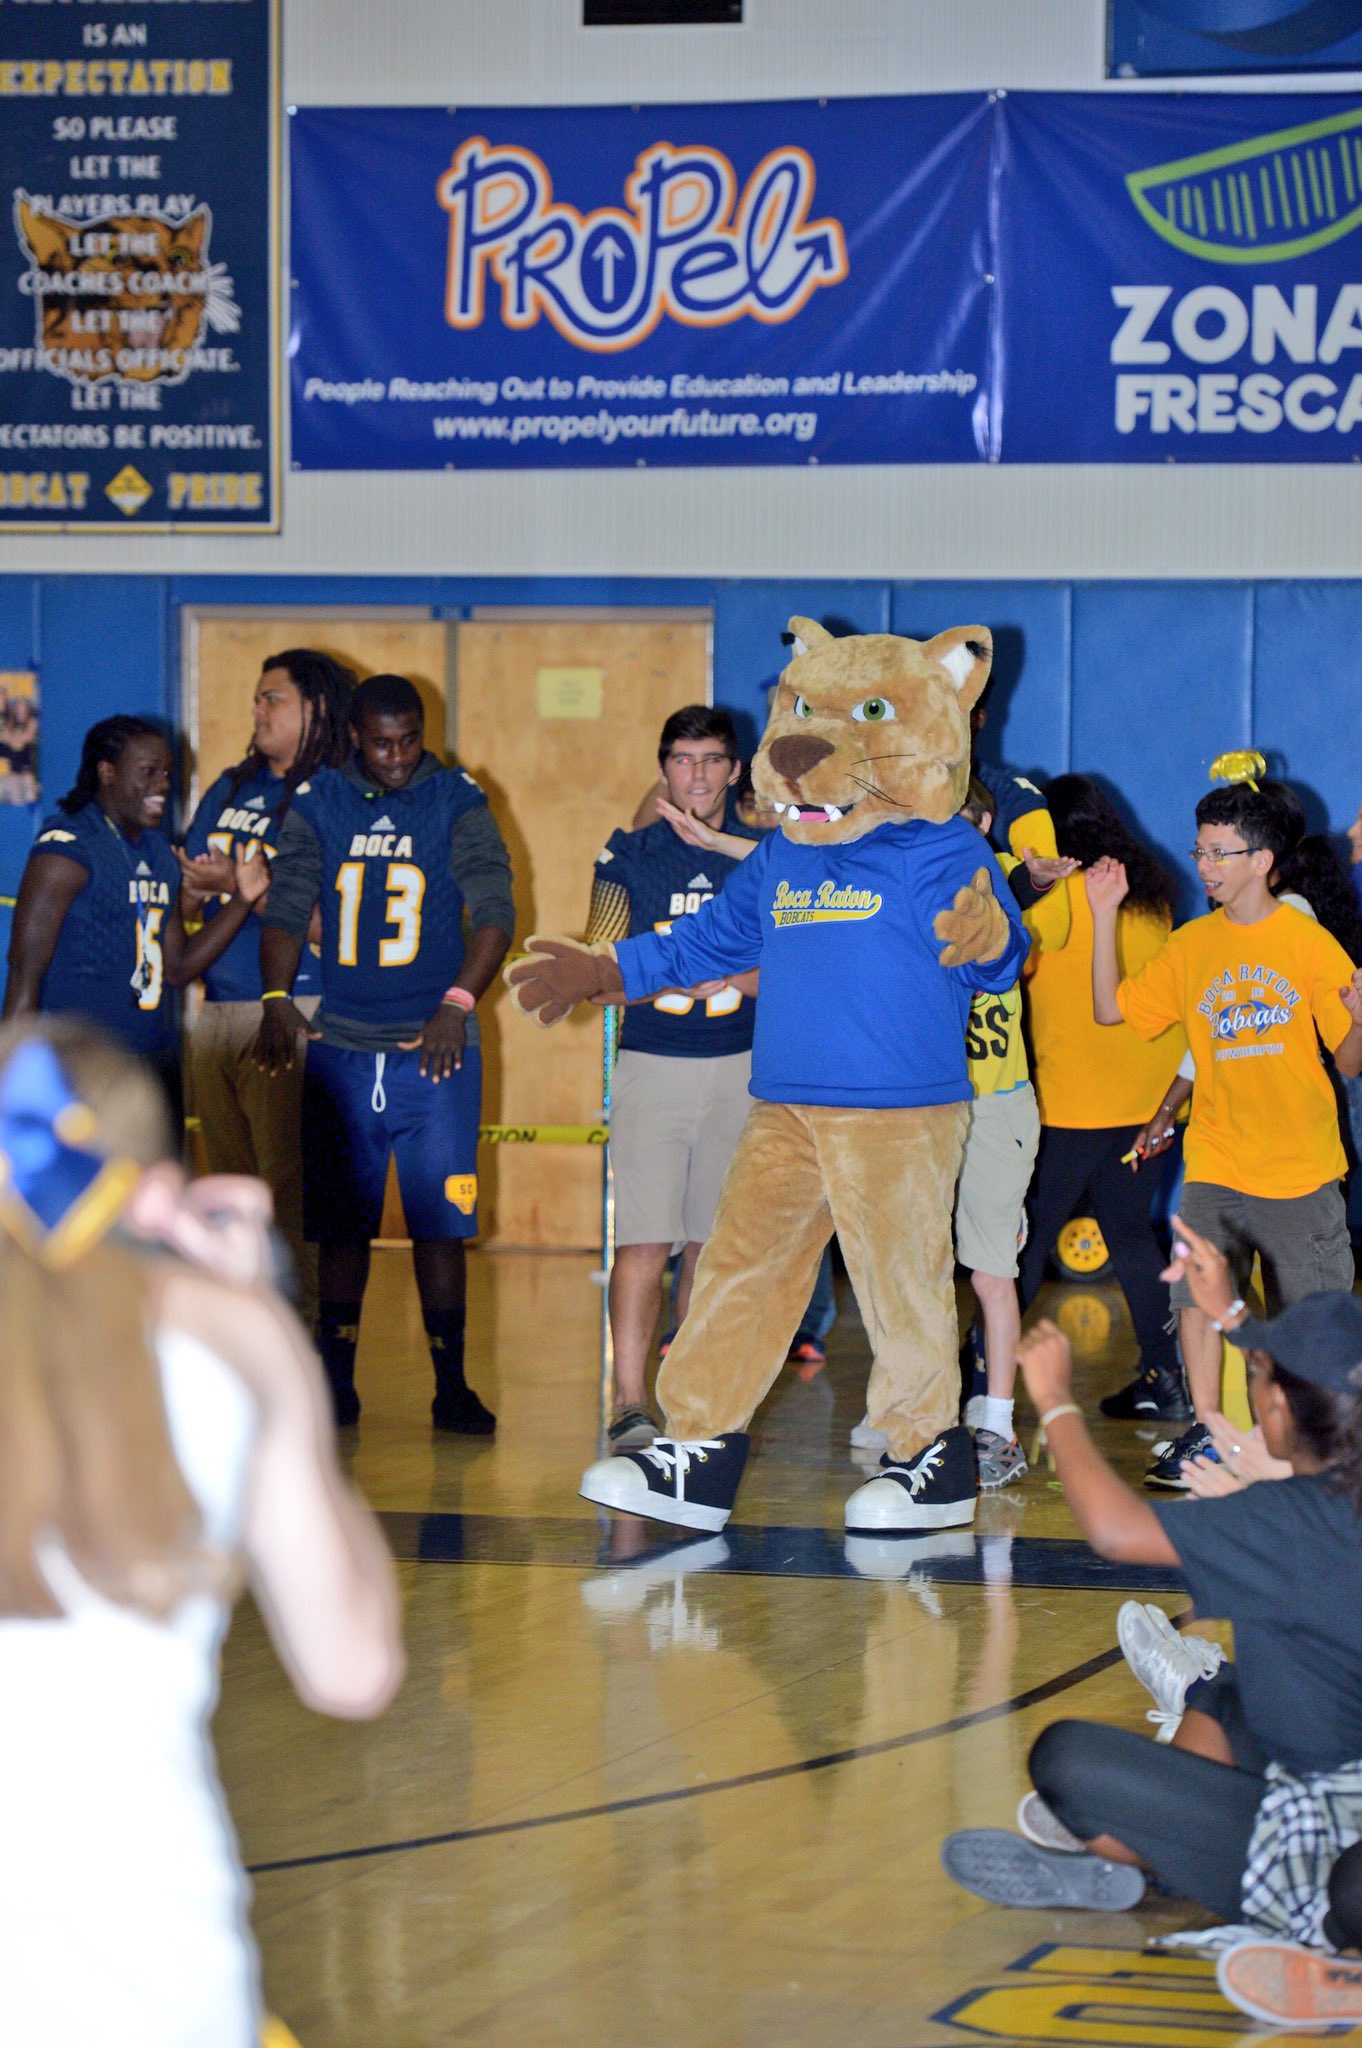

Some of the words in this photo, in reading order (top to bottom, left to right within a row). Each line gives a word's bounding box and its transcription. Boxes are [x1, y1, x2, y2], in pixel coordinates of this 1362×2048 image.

[82, 23, 107, 46] IS
[112, 23, 147, 46] AN
[0, 58, 233, 96] EXPECTATION
[52, 116, 86, 140] SO
[89, 116, 178, 140] PLEASE
[69, 155, 112, 179] LET
[115, 155, 161, 179] THE
[29, 194, 133, 216] PLAYERS
[136, 194, 195, 216] PLAY
[69, 233, 112, 256] LET
[117, 233, 161, 256] THE
[18, 271, 125, 295] COACHES
[128, 271, 207, 295] COACH
[70, 310, 112, 333] LET
[118, 310, 161, 333] THE
[116, 348, 241, 372] OFFICIATE.
[71, 386, 113, 411] LET
[118, 386, 162, 411] THE
[304, 377, 386, 406] People
[388, 376, 498, 406] Reaching
[500, 376, 546, 401] Out
[549, 376, 574, 401] to
[576, 374, 666, 400] Provide
[670, 373, 789, 399] Education
[792, 371, 840, 396] and
[843, 369, 977, 397] Leadership
[114, 425, 146, 449] BE
[151, 425, 262, 449] POSITIVE.
[433, 409, 817, 444] www.propelyourfuture.org
[167, 472, 263, 509] PRIDE
[216, 807, 271, 836] BOCA
[349, 834, 413, 858] BOCA
[128, 880, 169, 905] BOCA
[773, 880, 812, 909] Boca
[815, 880, 875, 910] Raton
[334, 862, 427, 967] 13
[779, 911, 815, 925] BOBCATS
[1197, 968, 1235, 1017] BOCA
[1239, 963, 1302, 1008] RATON
[1209, 1003, 1293, 1039] Bobcats
[478, 1129, 538, 1144] TION
